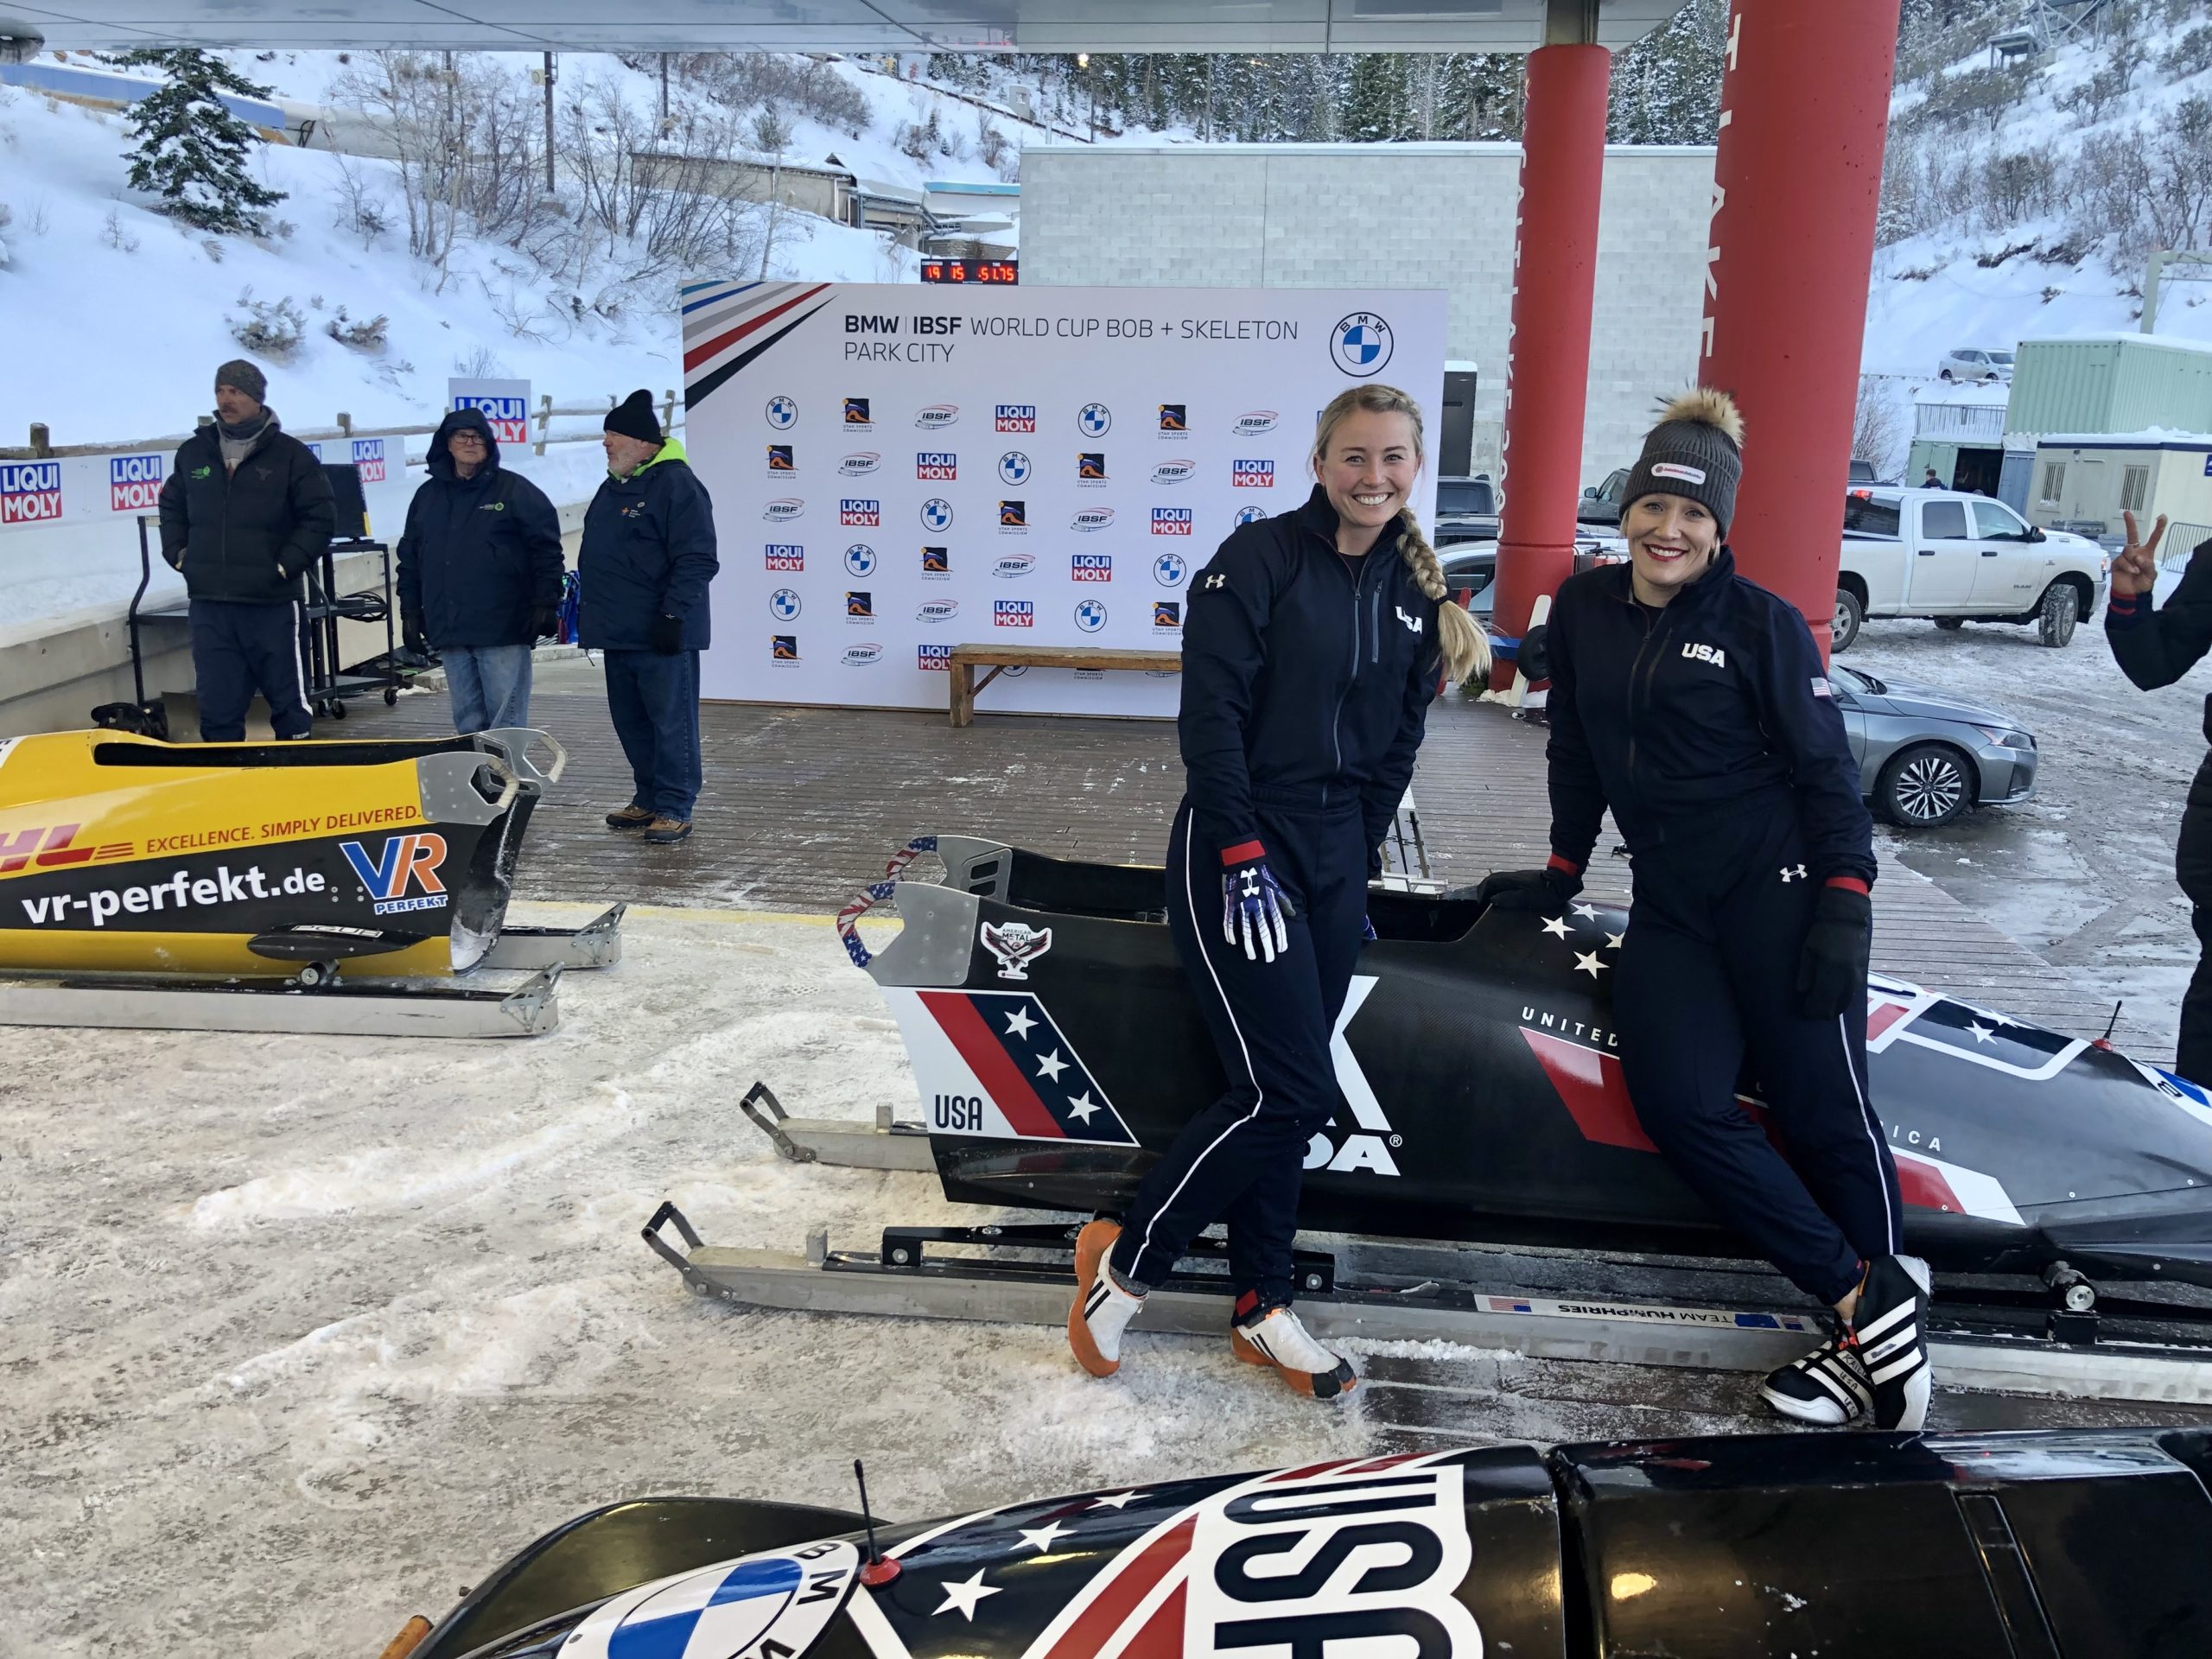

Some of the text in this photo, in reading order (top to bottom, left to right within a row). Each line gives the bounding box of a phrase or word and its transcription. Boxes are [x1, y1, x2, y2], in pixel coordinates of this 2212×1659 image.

[928, 266, 941, 279] 19
[952, 267, 965, 280] 15
[845, 315, 899, 334] BMW
[913, 316, 962, 334] IBSF
[970, 317, 1049, 337] WORLD
[1057, 318, 1099, 338] CUP
[1107, 319, 1153, 339] BOB
[1181, 320, 1298, 340] SKELETON
[845, 342, 955, 363] PARK CITY
[996, 406, 1034, 419] LIQUI
[996, 419, 1034, 432] MOLY
[353, 441, 383, 461] LIQUI
[918, 454, 956, 467] LIQUI
[112, 457, 160, 482] LIQUI
[918, 467, 956, 480] MOLY
[1235, 461, 1273, 474] LIQUI
[3, 465, 58, 493] LIQUI
[1234, 474, 1273, 486] MOLY
[113, 482, 162, 508] MOLY
[4, 493, 60, 520] MOLY
[842, 500, 878, 513] LIQUI
[842, 513, 879, 525] MOLY
[1153, 509, 1190, 522] LIQUI
[1153, 522, 1191, 534] MOLY
[766, 545, 802, 558] LIQUI
[767, 558, 804, 571] MOLY
[1074, 556, 1110, 569] LIQUI
[1073, 569, 1110, 581] MOLY
[995, 601, 1033, 614] LIQUI
[995, 614, 1033, 626] MOLY
[920, 645, 954, 658] LIQU
[1681, 643, 1725, 668] USA
[147, 805, 422, 854] EXCELLENCE. SIMPLY DELIVERED.
[0, 823, 97, 873] HL
[339, 832, 448, 900] VR
[22, 866, 325, 926] vr-perfekt.de
[374, 894, 448, 915] PERFEKT
[1002, 933, 1031, 942] METAL
[1522, 1006, 1618, 1047] UNITED
[935, 1094, 983, 1131] USA
[1558, 1304, 1732, 1324] TEAM HUMPHRIES
